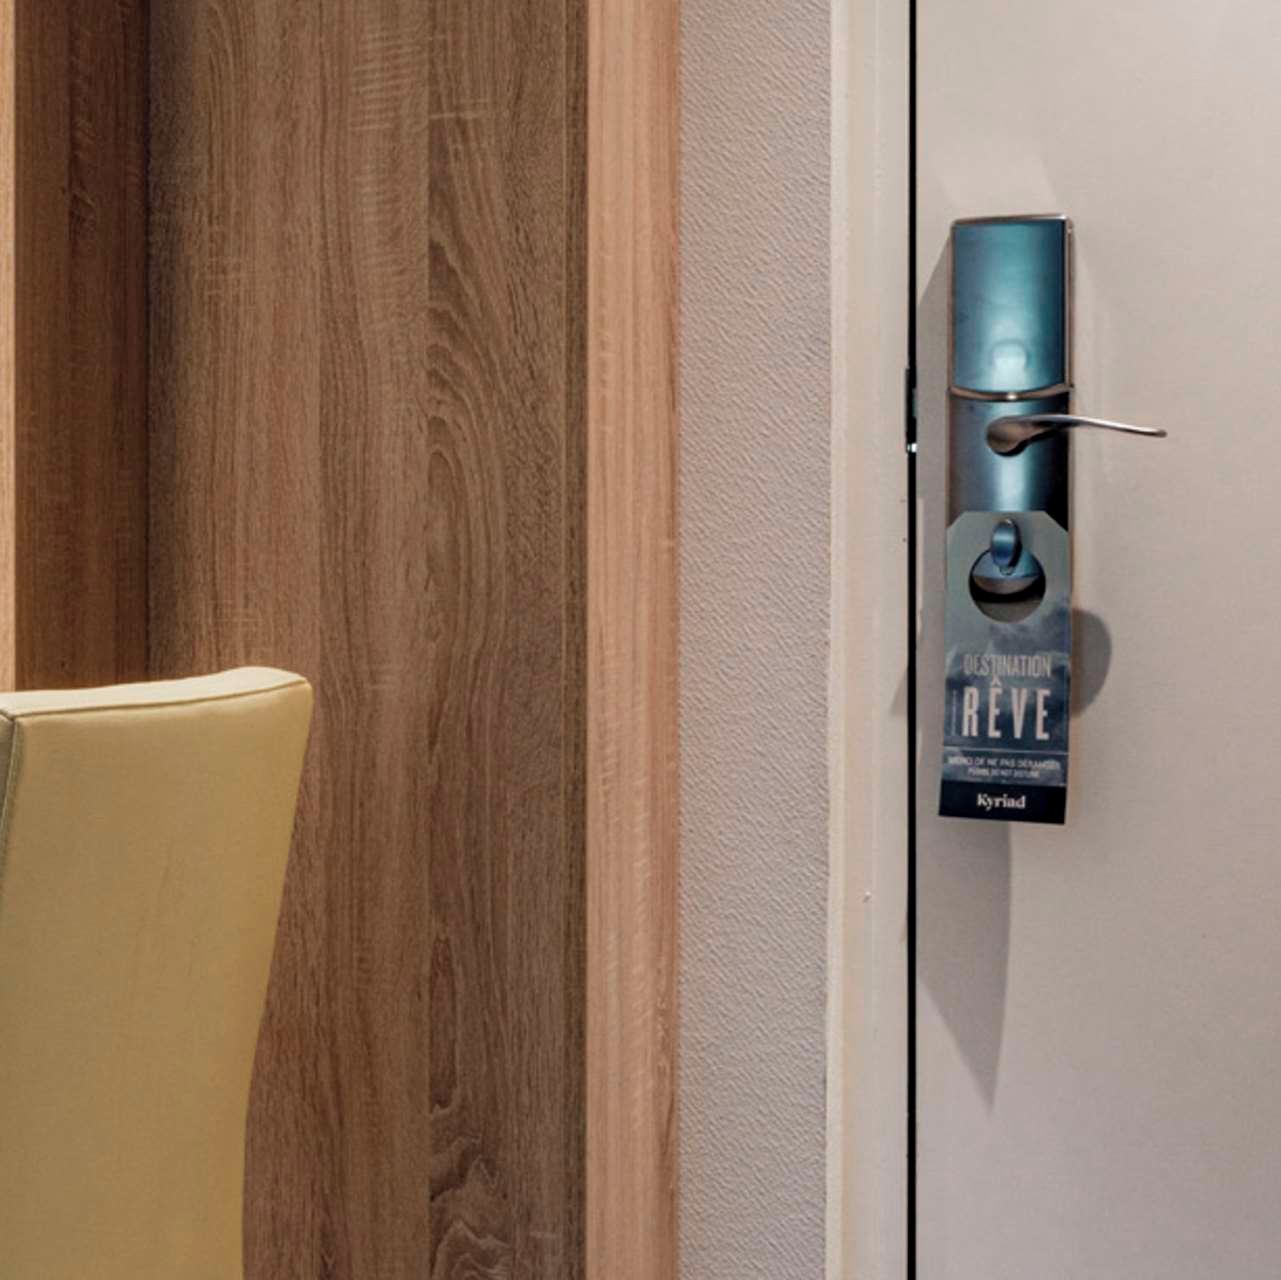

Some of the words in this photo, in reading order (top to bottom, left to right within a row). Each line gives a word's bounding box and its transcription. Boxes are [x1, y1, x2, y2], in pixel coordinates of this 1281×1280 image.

[963, 654, 1052, 678] DESTINATION
[962, 676, 1052, 740] RÊVE
[977, 793, 1026, 811] Kyriad
